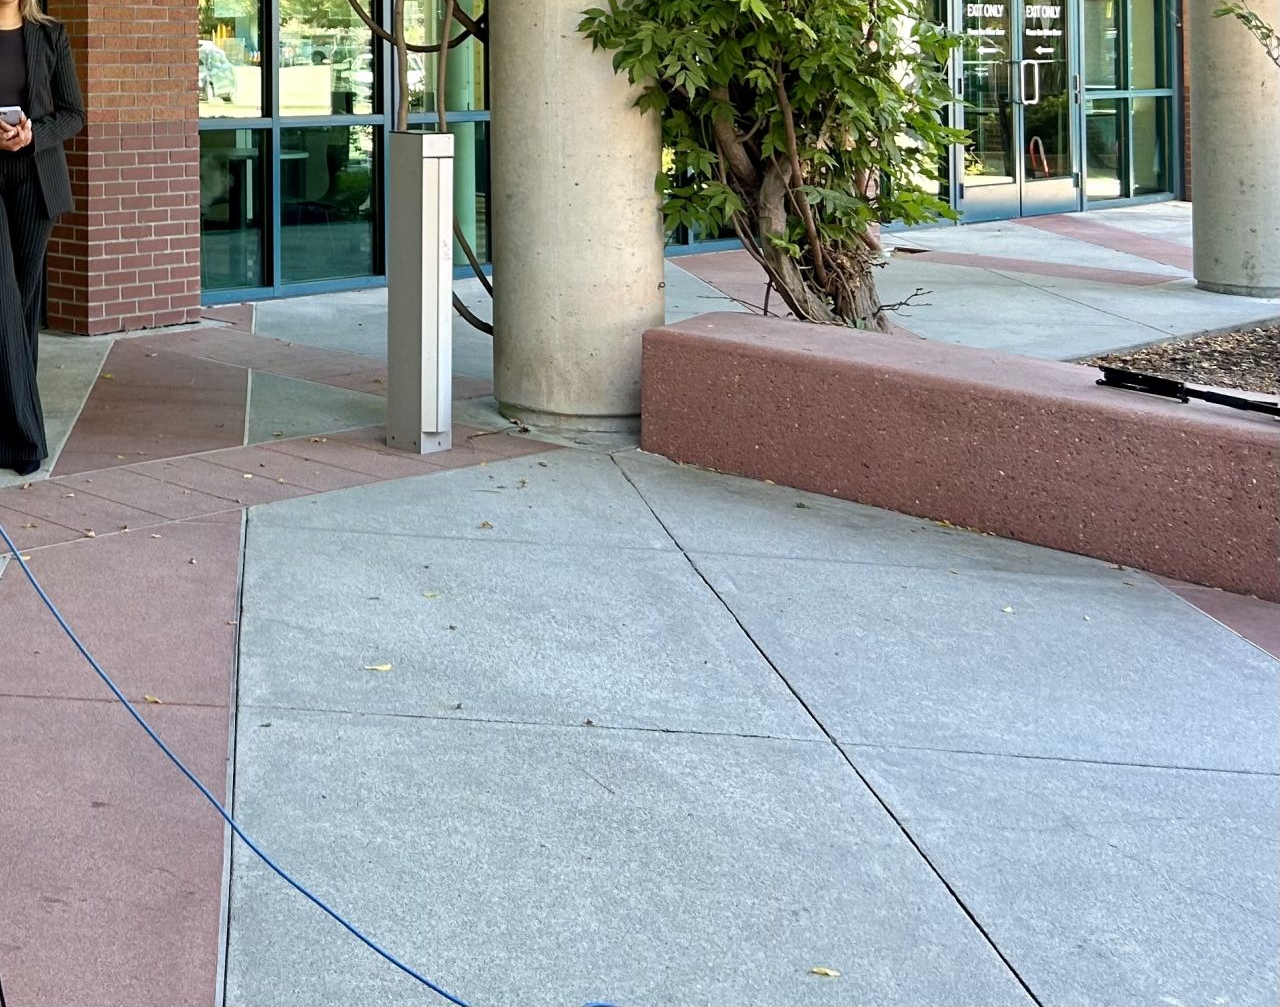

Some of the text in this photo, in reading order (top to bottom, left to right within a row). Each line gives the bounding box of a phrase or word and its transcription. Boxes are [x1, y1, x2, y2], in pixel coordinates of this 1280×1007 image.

[967, 4, 1004, 17] EXIT ONLY
[1026, 5, 1060, 18] EXIT ONLY
